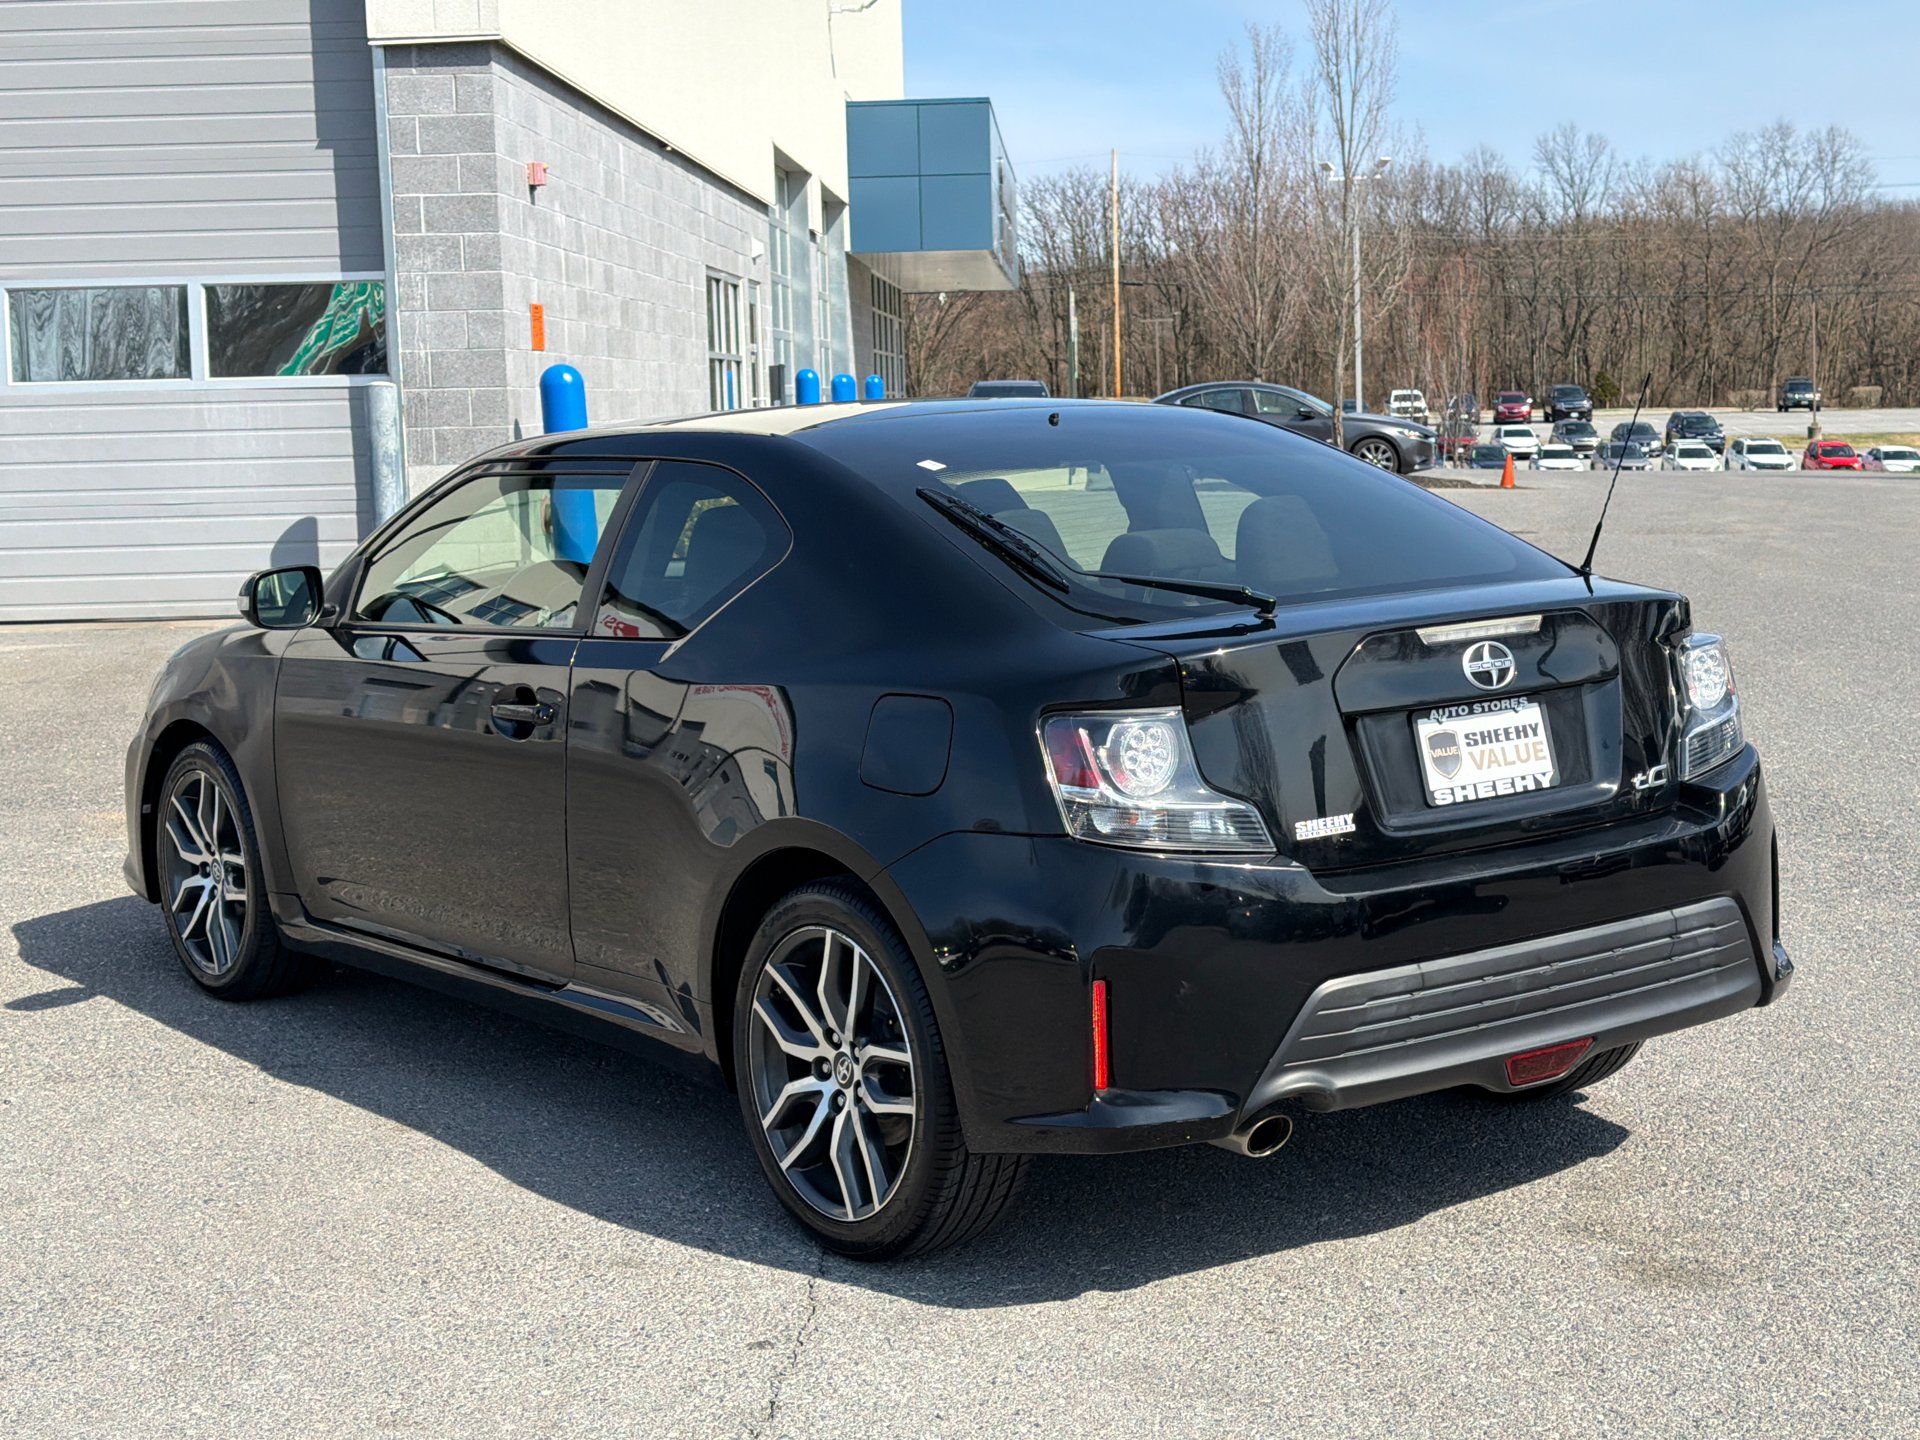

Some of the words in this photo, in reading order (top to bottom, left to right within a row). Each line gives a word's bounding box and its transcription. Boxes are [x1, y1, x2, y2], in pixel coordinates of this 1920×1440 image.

[1468, 659, 1513, 671] SCION
[1429, 705, 1469, 722] AUTO
[1473, 697, 1528, 714] STORES
[1464, 722, 1539, 747] SHEEHY
[1430, 746, 1459, 758] VALUE
[1467, 741, 1547, 770] VALUE
[1433, 770, 1555, 805] SHEEHY
[1631, 763, 1668, 789] tC
[1295, 813, 1354, 833] SHEEHY
